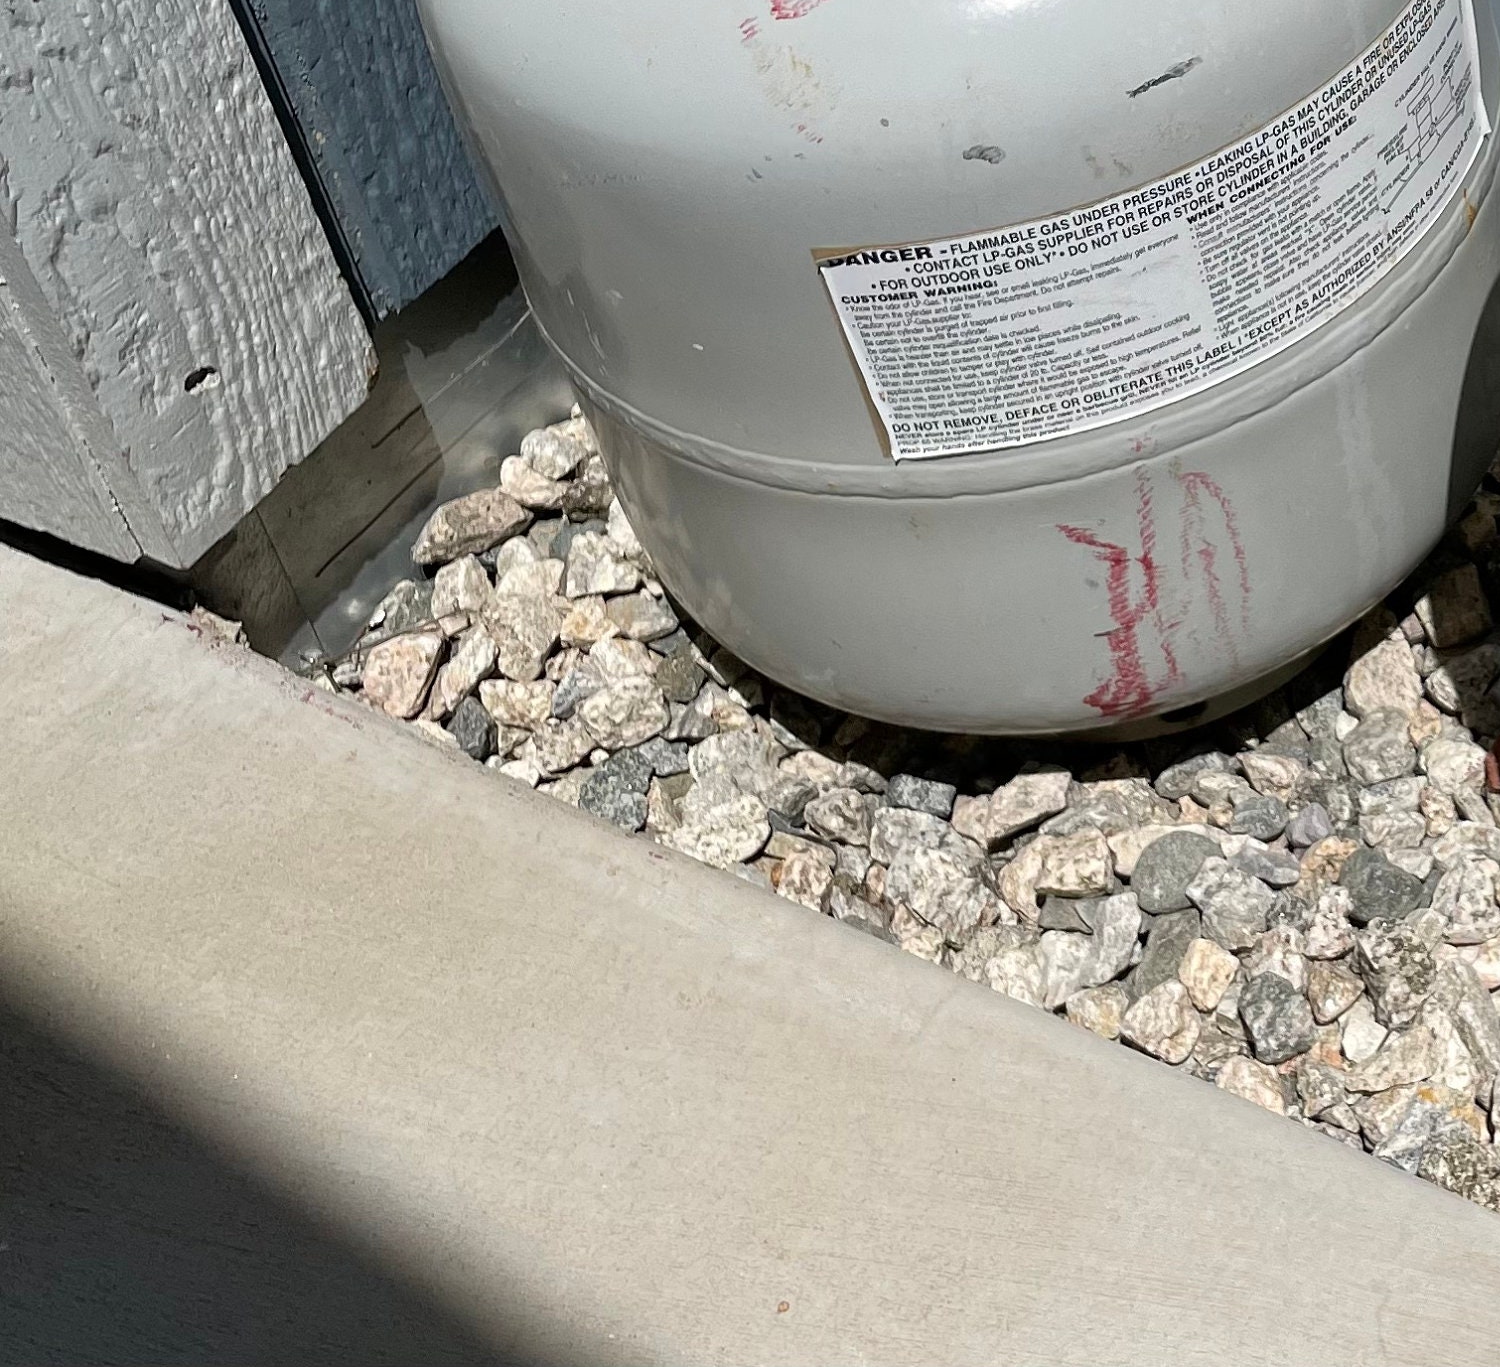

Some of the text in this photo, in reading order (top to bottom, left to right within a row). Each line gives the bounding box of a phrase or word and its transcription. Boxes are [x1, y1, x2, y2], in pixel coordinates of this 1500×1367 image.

[880, 278, 908, 291] FOR
[911, 268, 981, 288] OUTDOOR
[983, 261, 1012, 277] USE
[1068, 245, 1088, 256] DO
[1092, 235, 1119, 250] NOT
[1122, 225, 1150, 239] USE
[1152, 215, 1172, 227] OR
[1174, 196, 1215, 218] STORE
[1218, 159, 1274, 196] CYLINDER
[1277, 150, 1287, 165] IN
[1291, 144, 1298, 156] A
[1350, 73, 1386, 111] GARAGE
[1386, 61, 1399, 77] OR
[1400, 17, 1433, 64] ENCLOSED
[913, 0, 1431, 273] CONTACT LP-GAS SUPPLIER FOR REPAIRS OR DISPOSAL OF THIS CYLINDER OR UNUSED LP-GAS
[951, 229, 1037, 255] FLAMMABLE
[1041, 219, 1070, 236] GAS
[1072, 204, 1120, 226] UNDER
[1123, 173, 1192, 210] PRESSURE
[1200, 142, 1253, 176] LEAKING
[1255, 116, 1296, 146] LP-GAS
[1298, 99, 1318, 121] MAY
[1322, 72, 1353, 103] CAUSE
[1356, 65, 1362, 75] A
[1363, 44, 1382, 69] FIRE
[1382, 32, 1394, 48] OR
[1186, 202, 1224, 224] WHEN
[1230, 155, 1306, 203] CONNECTING
[1310, 136, 1331, 155] FOR
[841, 281, 998, 304] CUSTOMER WARNING:
[892, 423, 910, 433] DO
[914, 420, 940, 431] NOT
[945, 414, 1002, 429] REMOVE,
[1005, 403, 1058, 420] DEFACE
[1061, 396, 1080, 409] OR
[1084, 373, 1164, 404] OBLITERATE
[1165, 359, 1194, 377] THIS
[1196, 341, 1236, 364] LABEL
[1295, 300, 1309, 313] AS
[1312, 253, 1371, 301] AUTHORIZED
[1372, 241, 1384, 255] BY
[1434, 180, 1441, 189] or
